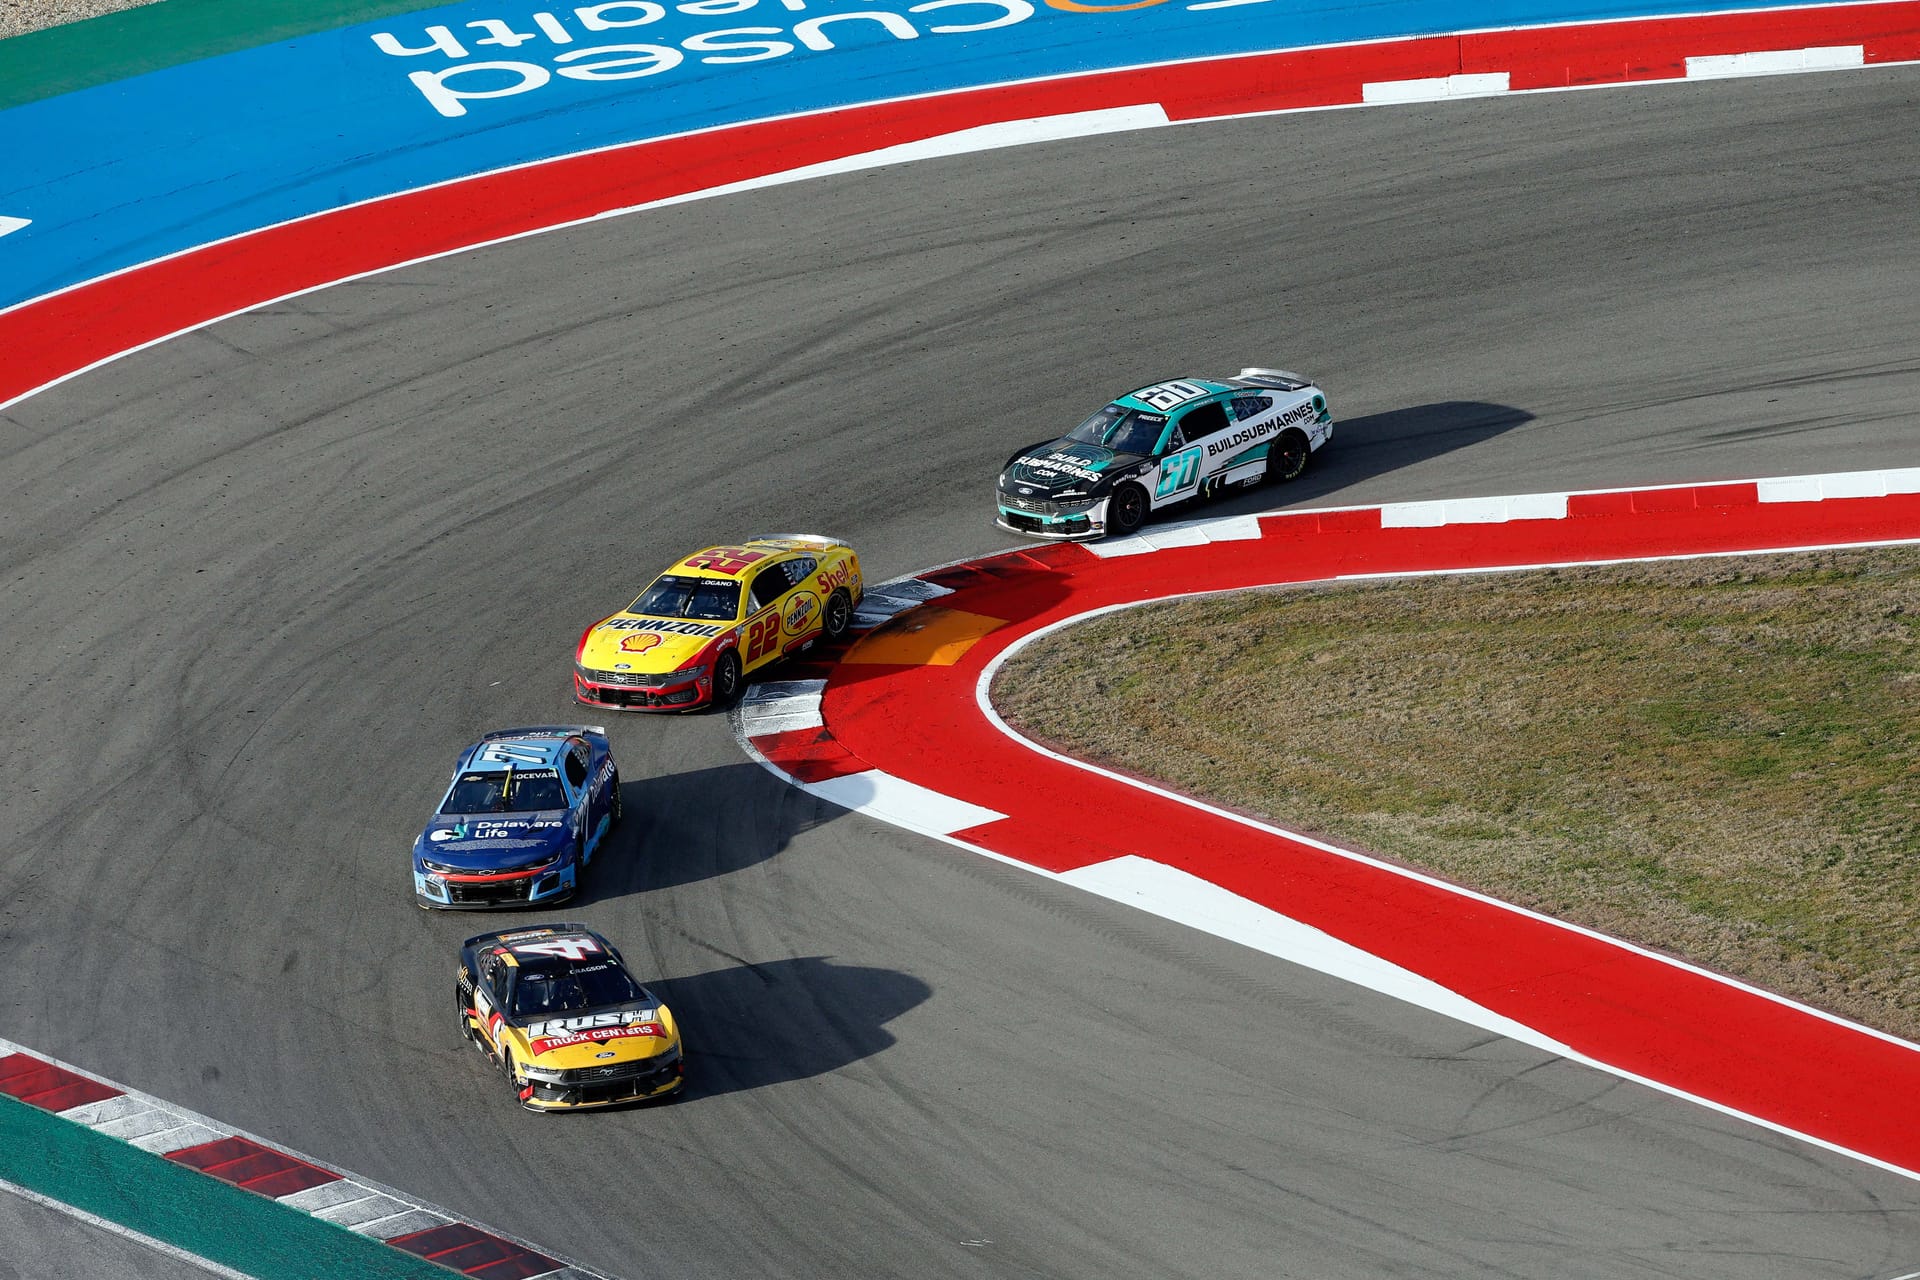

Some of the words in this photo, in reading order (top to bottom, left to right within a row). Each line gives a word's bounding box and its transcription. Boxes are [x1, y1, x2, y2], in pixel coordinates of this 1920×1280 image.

[408, 0, 1290, 117] cused
[1207, 402, 1314, 457] BUILDSUBMARINES
[1015, 456, 1102, 482] SUBMARINES
[1049, 452, 1092, 466] BUILD
[1156, 448, 1199, 497] 60
[684, 548, 767, 576] 22
[816, 560, 850, 594] Shell
[786, 598, 813, 629] PENNZOIL
[597, 618, 725, 638] PENNZOIL
[746, 612, 781, 665] 22
[474, 830, 509, 838] Life
[476, 821, 563, 829] Delaware
[511, 938, 602, 960] 4
[528, 1009, 656, 1038] RUSH
[544, 1030, 591, 1048] TRUCK
[592, 1025, 654, 1040] CENTERS
